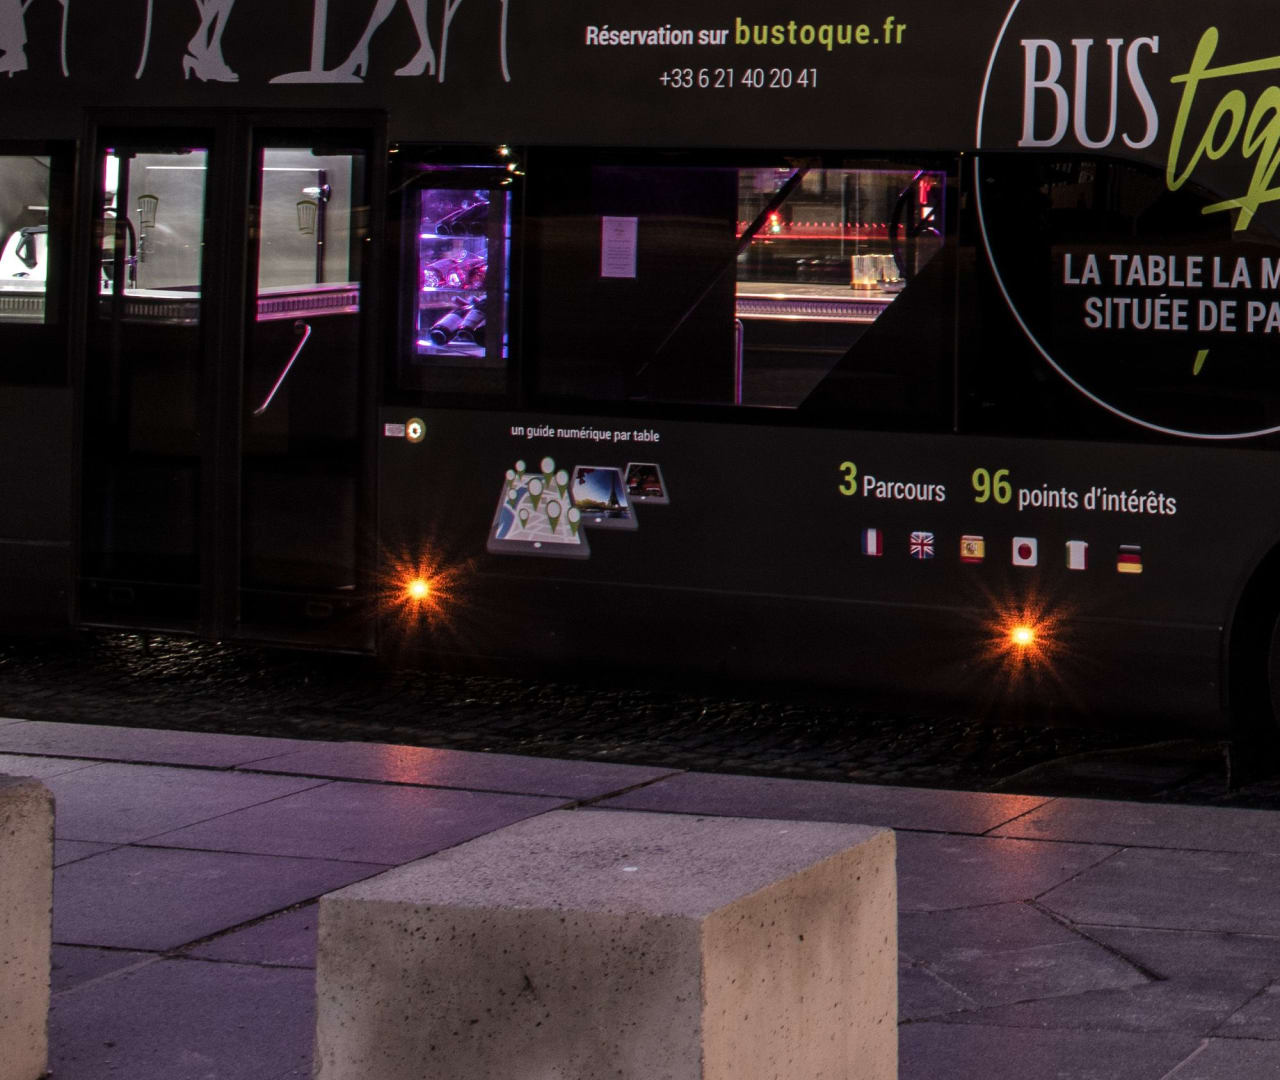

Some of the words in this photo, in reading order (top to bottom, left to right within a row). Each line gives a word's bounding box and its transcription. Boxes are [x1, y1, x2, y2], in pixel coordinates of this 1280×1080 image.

[585, 24, 694, 46] Réservation
[698, 28, 729, 46] sur
[735, 16, 907, 52] bustoque.fr
[659, 68, 693, 88] +33
[698, 68, 710, 88] 6
[714, 67, 734, 88] 21
[741, 67, 765, 88] 40
[770, 67, 792, 88] 20
[797, 67, 818, 88] 41
[1016, 34, 1160, 150] BUS
[1063, 253, 1101, 286] LA
[1109, 254, 1203, 288] TABLE
[1213, 256, 1252, 290] LA
[1084, 293, 1188, 331] SITUÉE
[1197, 299, 1238, 332] DE
[511, 426, 525, 436] un
[526, 425, 555, 439] guide
[557, 427, 611, 442] numérique
[614, 430, 631, 442] par
[633, 429, 660, 442] table
[838, 460, 858, 497] 3
[862, 475, 946, 503] Parcours
[971, 468, 1012, 505] 96
[1018, 483, 1078, 512] points
[1083, 486, 1177, 515] d'intérêts
